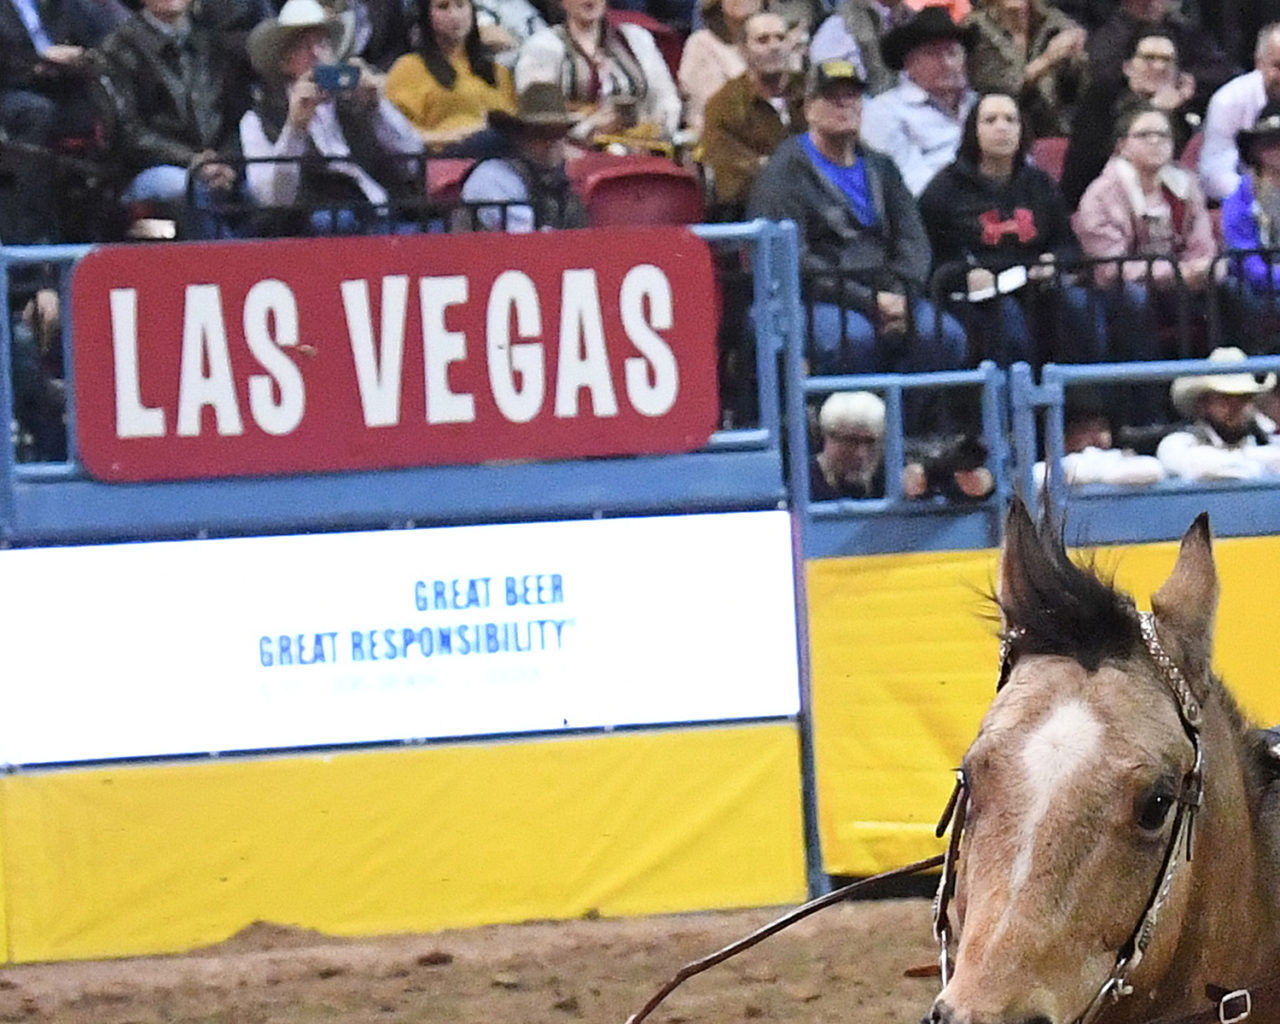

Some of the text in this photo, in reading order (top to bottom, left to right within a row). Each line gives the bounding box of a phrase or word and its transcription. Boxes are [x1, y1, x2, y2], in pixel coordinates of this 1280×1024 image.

[110, 264, 679, 437] LAS VEGAS
[414, 573, 565, 613] GREAT BEER
[258, 617, 566, 668] GREAT RESPONSIBILITY
